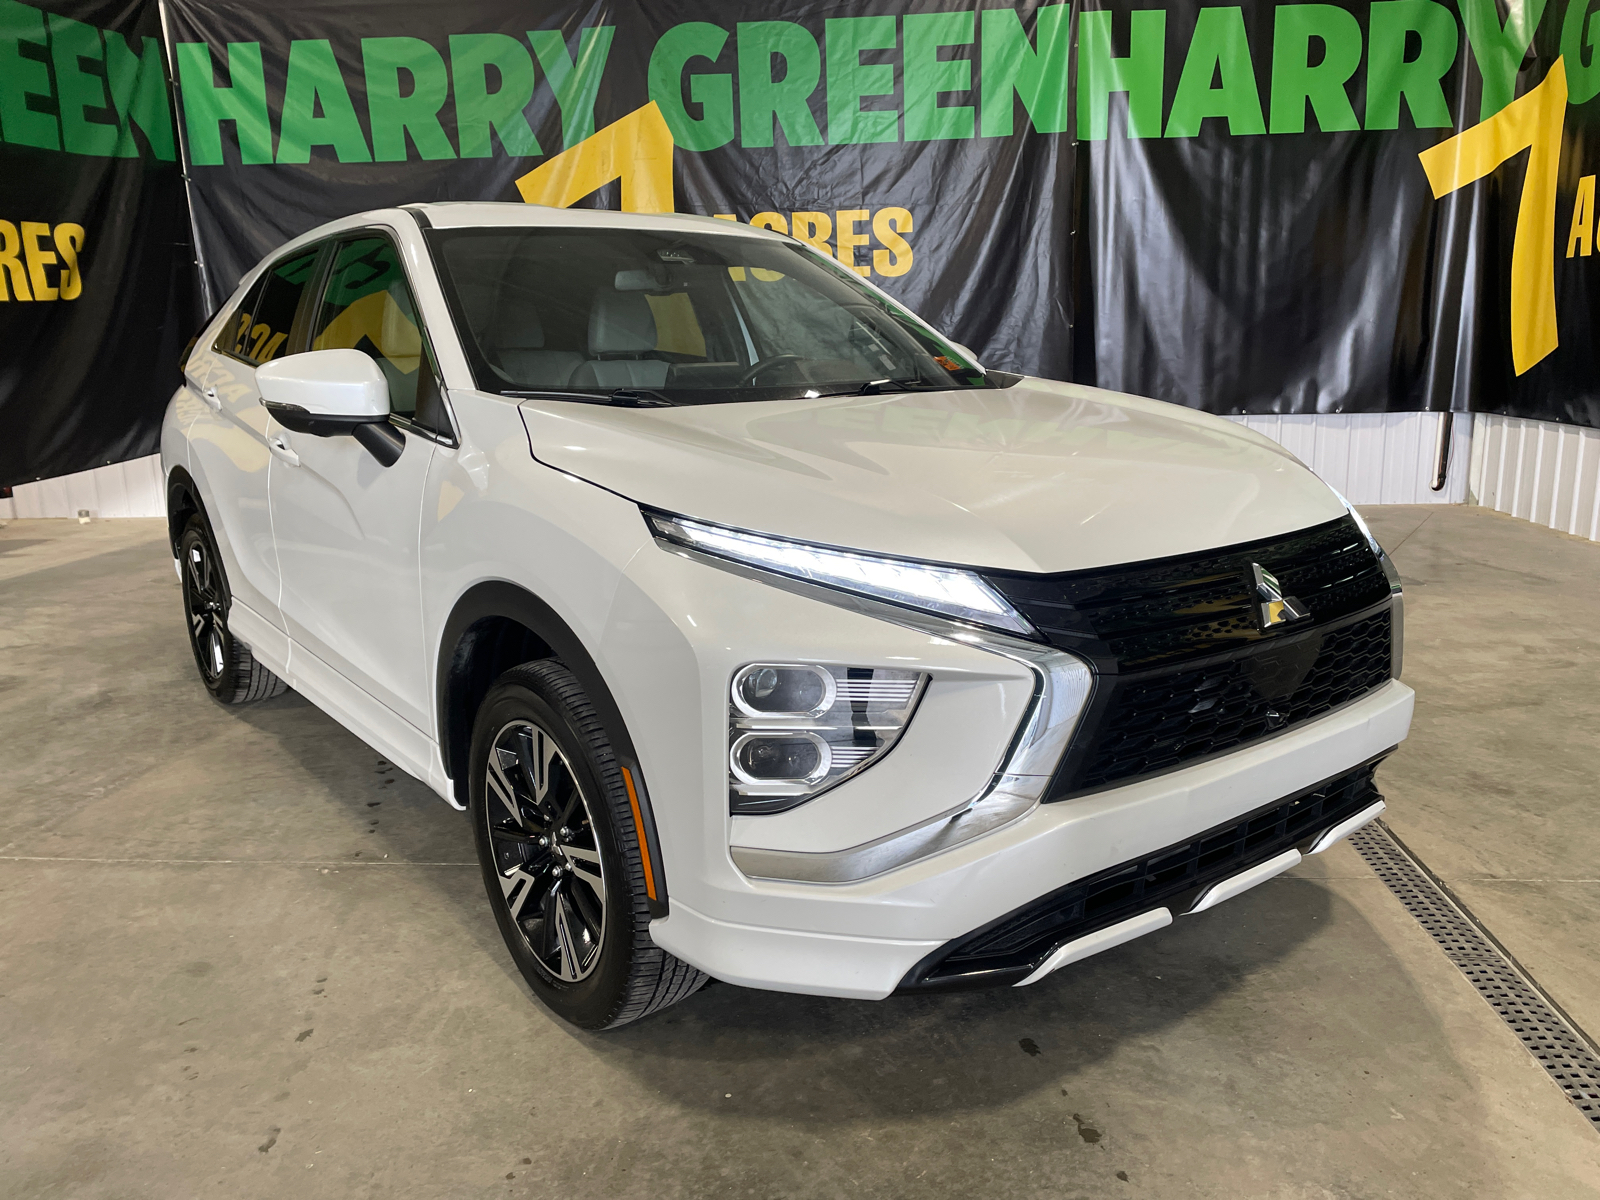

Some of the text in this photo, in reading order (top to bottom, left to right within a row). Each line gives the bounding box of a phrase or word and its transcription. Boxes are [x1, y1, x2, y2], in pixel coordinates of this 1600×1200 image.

[0, 0, 176, 161] EEN
[176, 4, 1070, 165] HARRY GREEN
[1077, 0, 1548, 141] HARRY
[1418, 54, 1600, 376] 7 A
